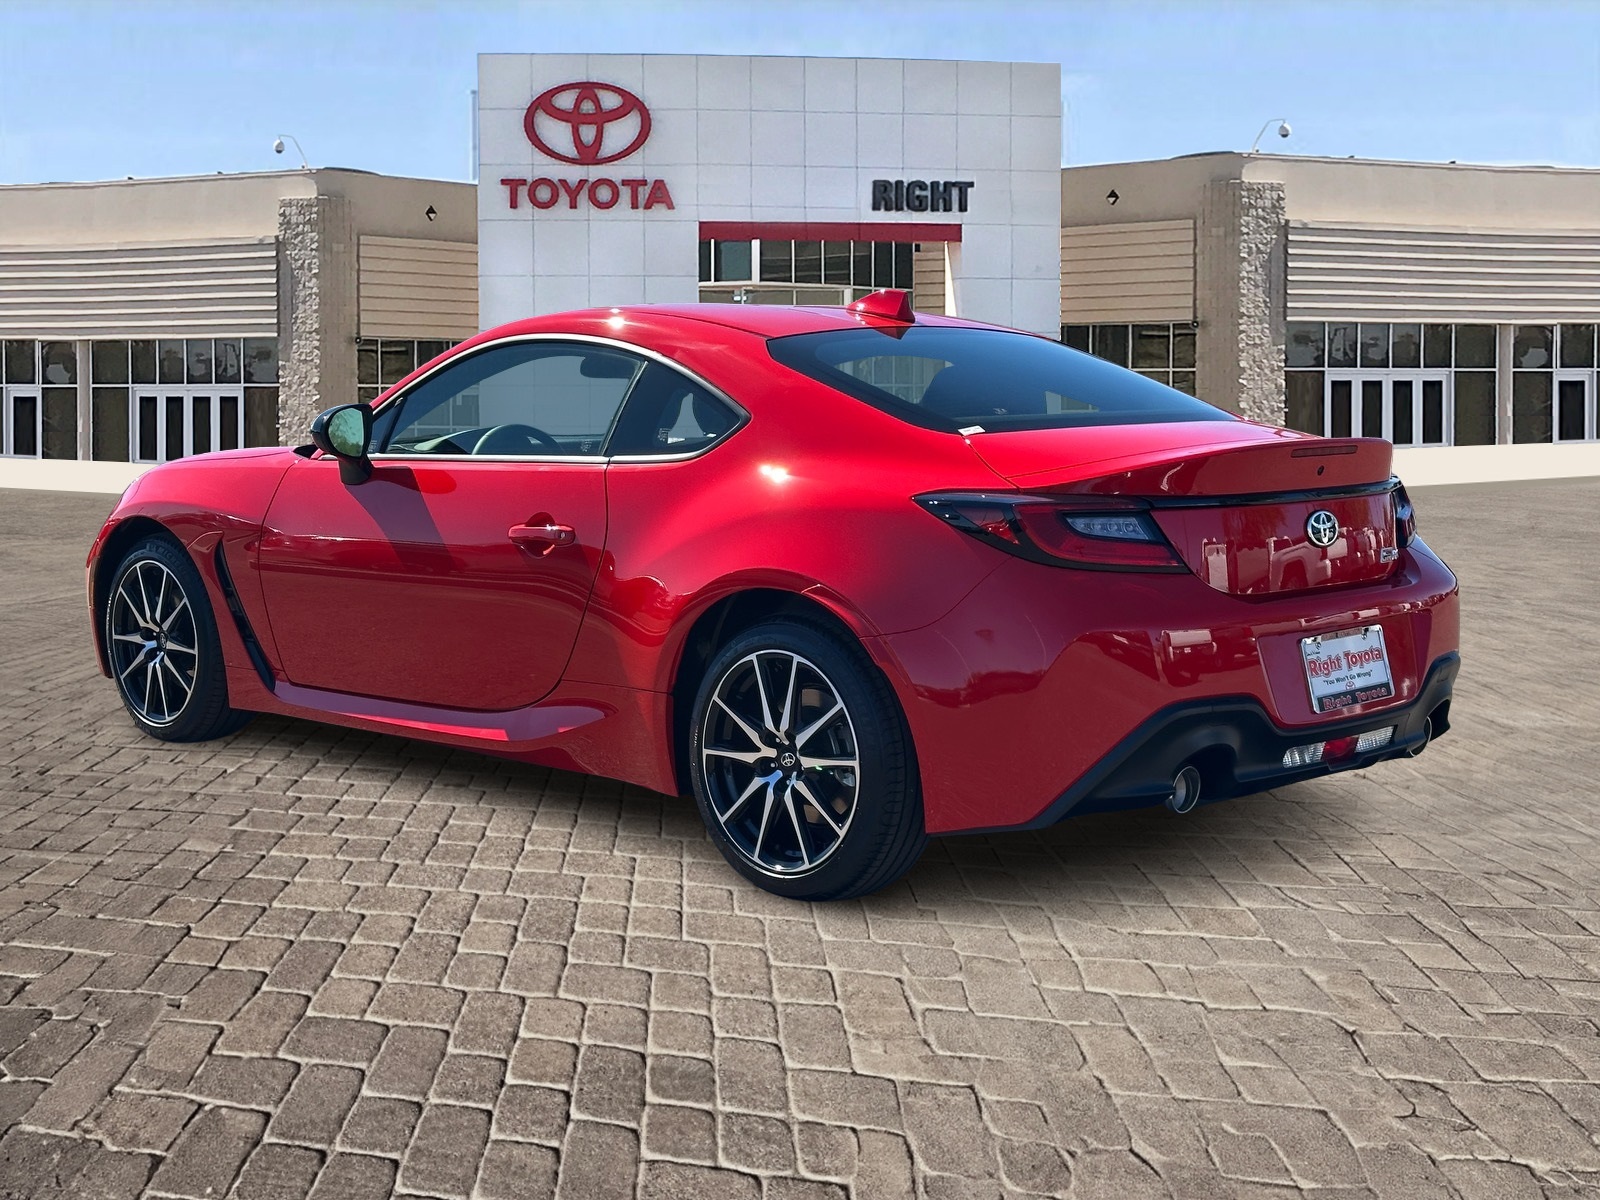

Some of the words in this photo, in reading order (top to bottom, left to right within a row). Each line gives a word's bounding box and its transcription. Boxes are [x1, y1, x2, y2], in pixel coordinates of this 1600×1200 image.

[500, 178, 675, 210] TOYOTA
[871, 180, 975, 213] RIGHT
[1307, 654, 1342, 678] Right
[1343, 646, 1384, 671] Toyota
[1322, 695, 1352, 710] Right
[1355, 687, 1388, 701] Toyota
